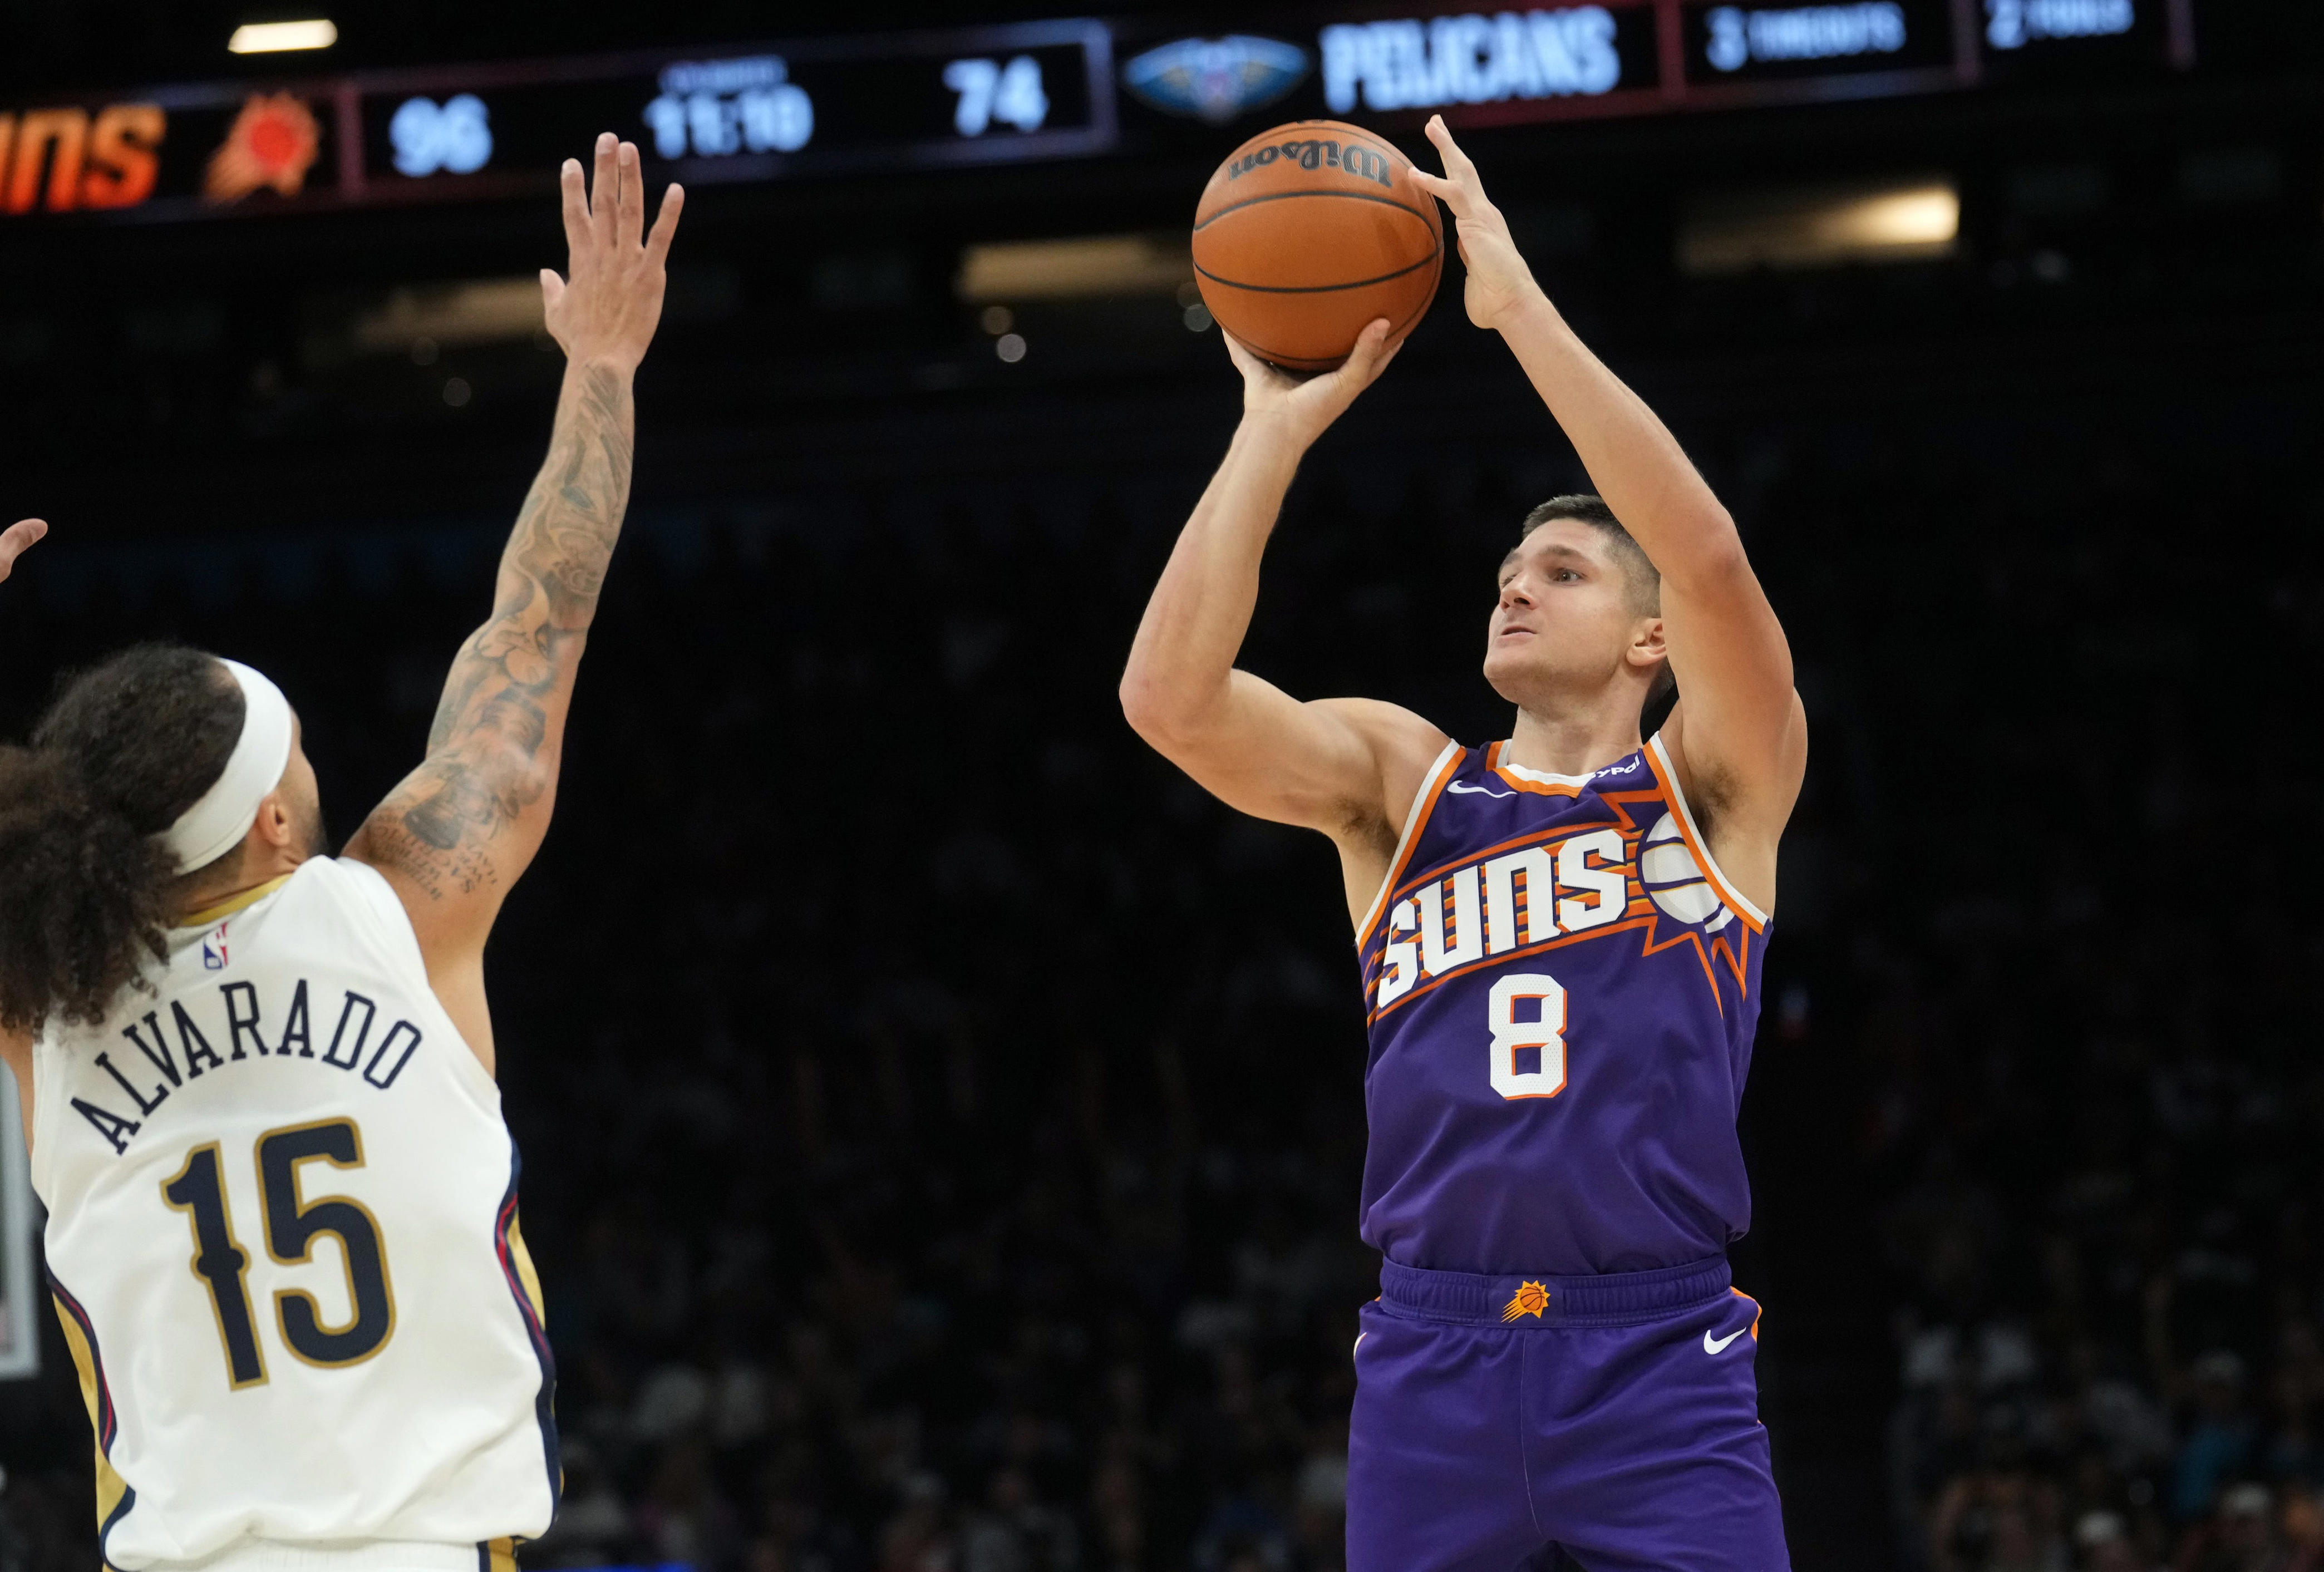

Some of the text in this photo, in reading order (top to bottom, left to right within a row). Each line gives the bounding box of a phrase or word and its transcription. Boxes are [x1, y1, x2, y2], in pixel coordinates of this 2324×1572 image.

[1320, 6, 1620, 114] PELICANS
[1706, 6, 1746, 71] 3
[390, 93, 493, 177] 96
[943, 55, 1048, 137] 74
[1228, 140, 1392, 187] Wilson
[70, 979, 422, 1155] ALVARADO
[1489, 973, 1568, 1100] 8
[160, 1116, 397, 1392] 15
